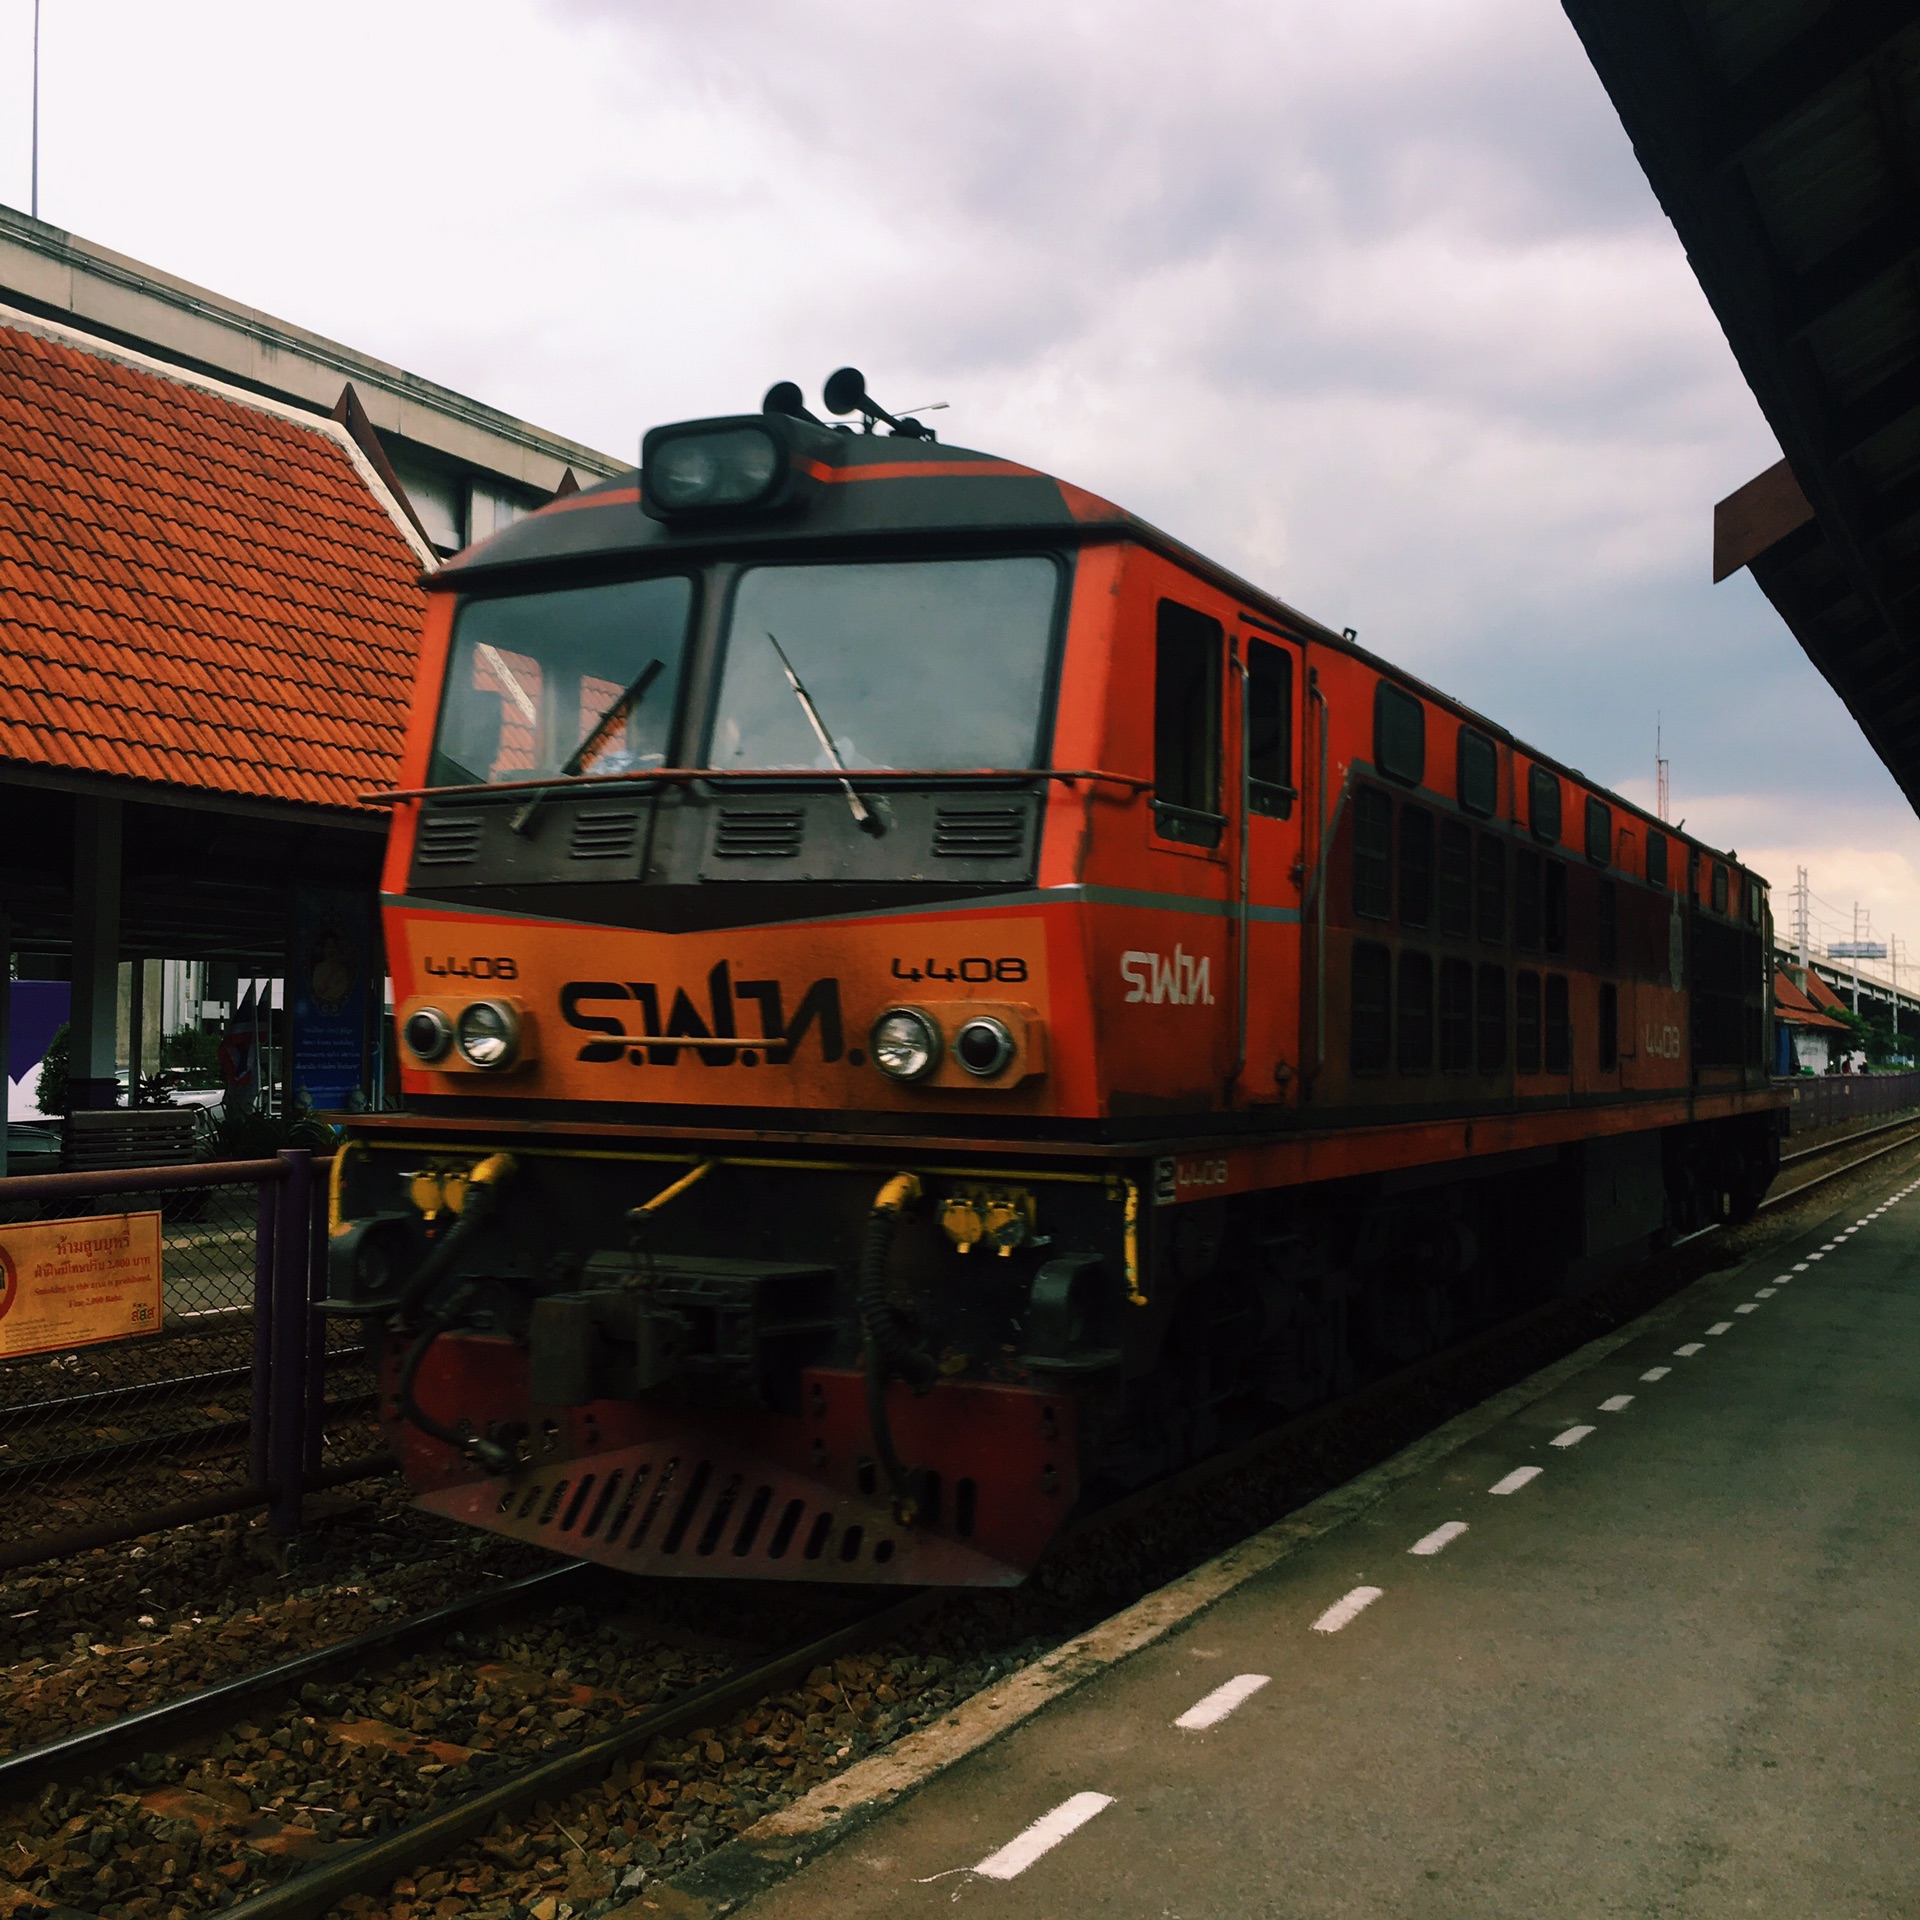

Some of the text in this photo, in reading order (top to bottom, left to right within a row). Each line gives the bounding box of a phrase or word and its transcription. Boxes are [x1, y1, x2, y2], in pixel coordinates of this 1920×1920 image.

[424, 956, 519, 981] 4408
[891, 957, 1027, 983] 4408
[1645, 1024, 1681, 1059] 4408
[1177, 1159, 1229, 1187] 4408
[56, 1230, 131, 1258] ห้ามสูบบุหรี่
[133, 1255, 151, 1267] บาท
[34, 1285, 67, 1296] Smoking
